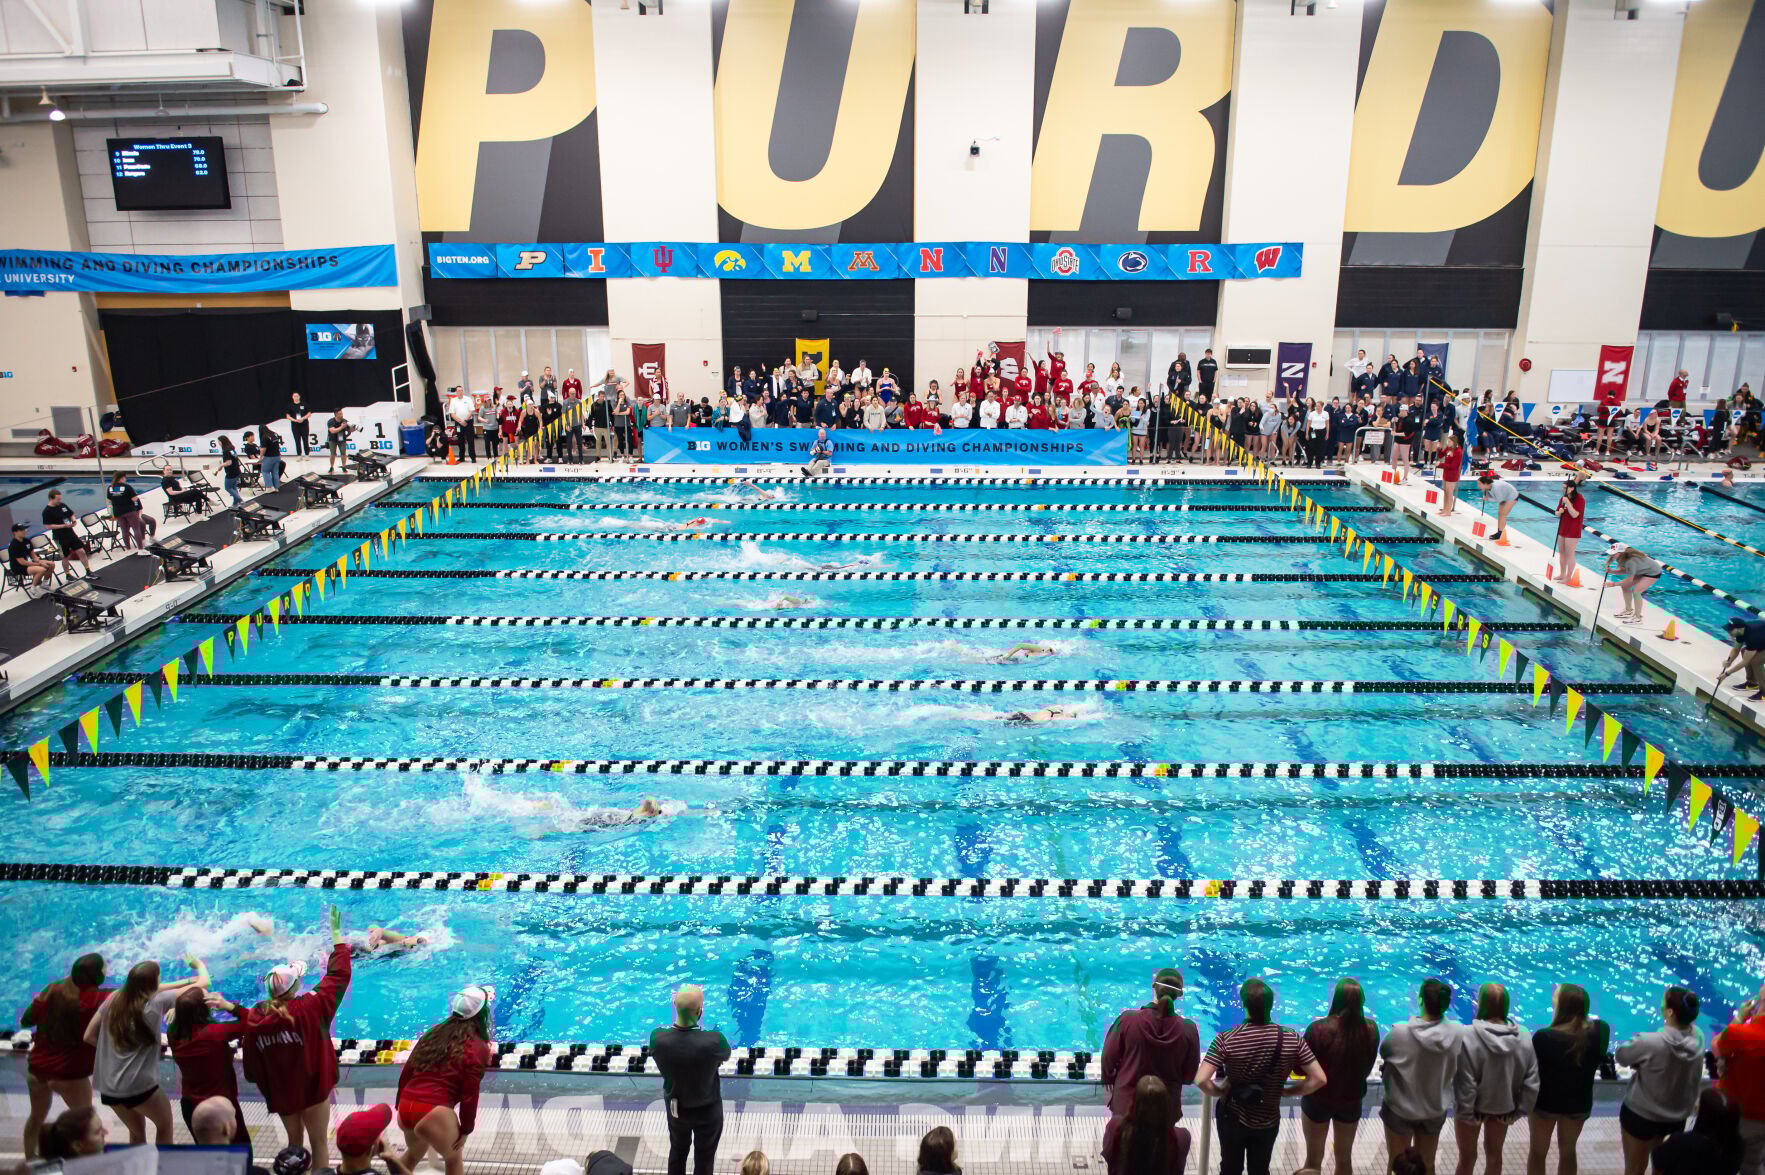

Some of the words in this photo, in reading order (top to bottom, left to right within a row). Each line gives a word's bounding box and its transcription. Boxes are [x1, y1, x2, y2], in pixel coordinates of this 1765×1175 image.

[81, 258, 116, 272] AND
[122, 260, 184, 274] DIVING
[190, 255, 339, 274] CHAMPIONSHIPS
[436, 256, 490, 264] BIGTEN.ORG
[781, 250, 812, 272] M
[919, 247, 944, 272] N
[989, 246, 1008, 273] N
[1187, 250, 1214, 273] R
[4, 274, 75, 284] UNIVERSITY
[309, 433, 319, 446] 3
[374, 422, 386, 439] 1
[716, 441, 784, 452] WOMEN'S
[871, 442, 901, 453] AND
[906, 442, 957, 453] DIVING
[961, 442, 1085, 453] CHAMPIONSHIPS
